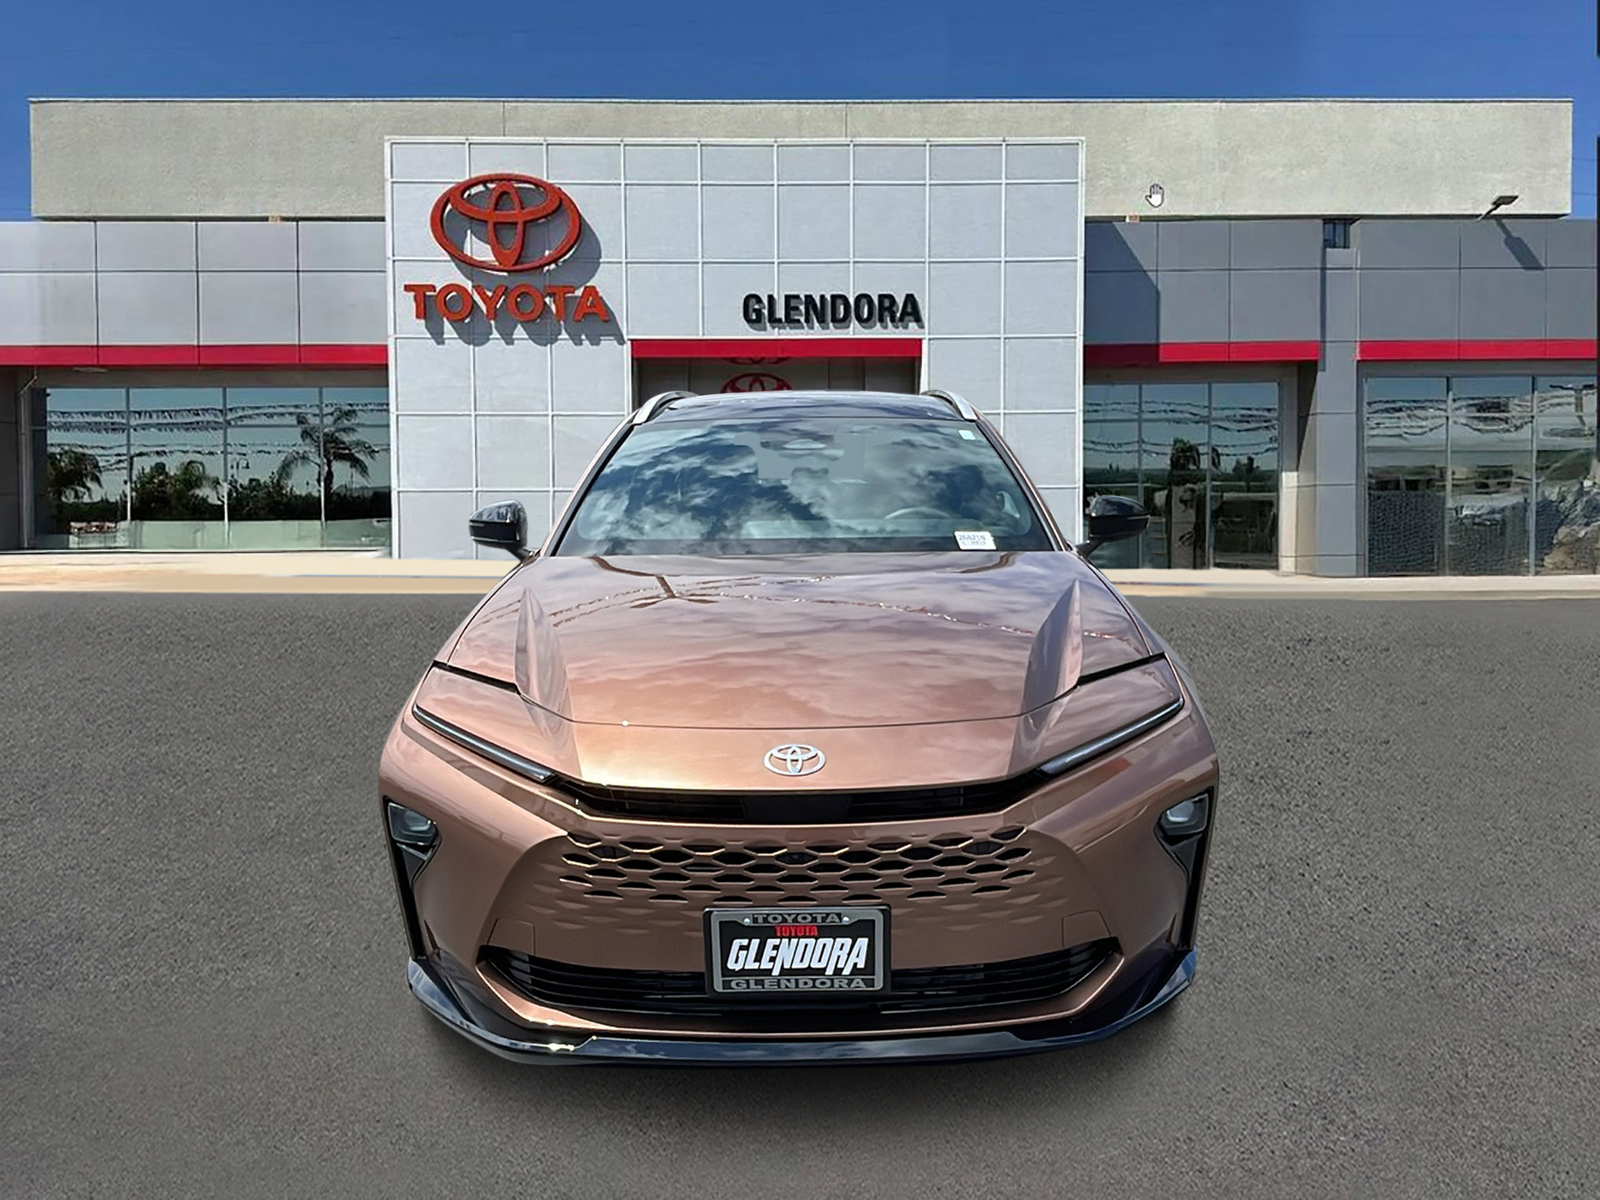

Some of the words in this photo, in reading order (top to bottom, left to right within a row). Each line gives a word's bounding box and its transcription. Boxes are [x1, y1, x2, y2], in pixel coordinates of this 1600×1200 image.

[404, 283, 610, 322] TOYOTA
[742, 293, 922, 325] GLENDORA
[753, 913, 840, 924] TOYOTA
[775, 925, 818, 937] TOYOTA
[727, 938, 869, 976] GLENDORA
[730, 978, 867, 990] GLENDORA
